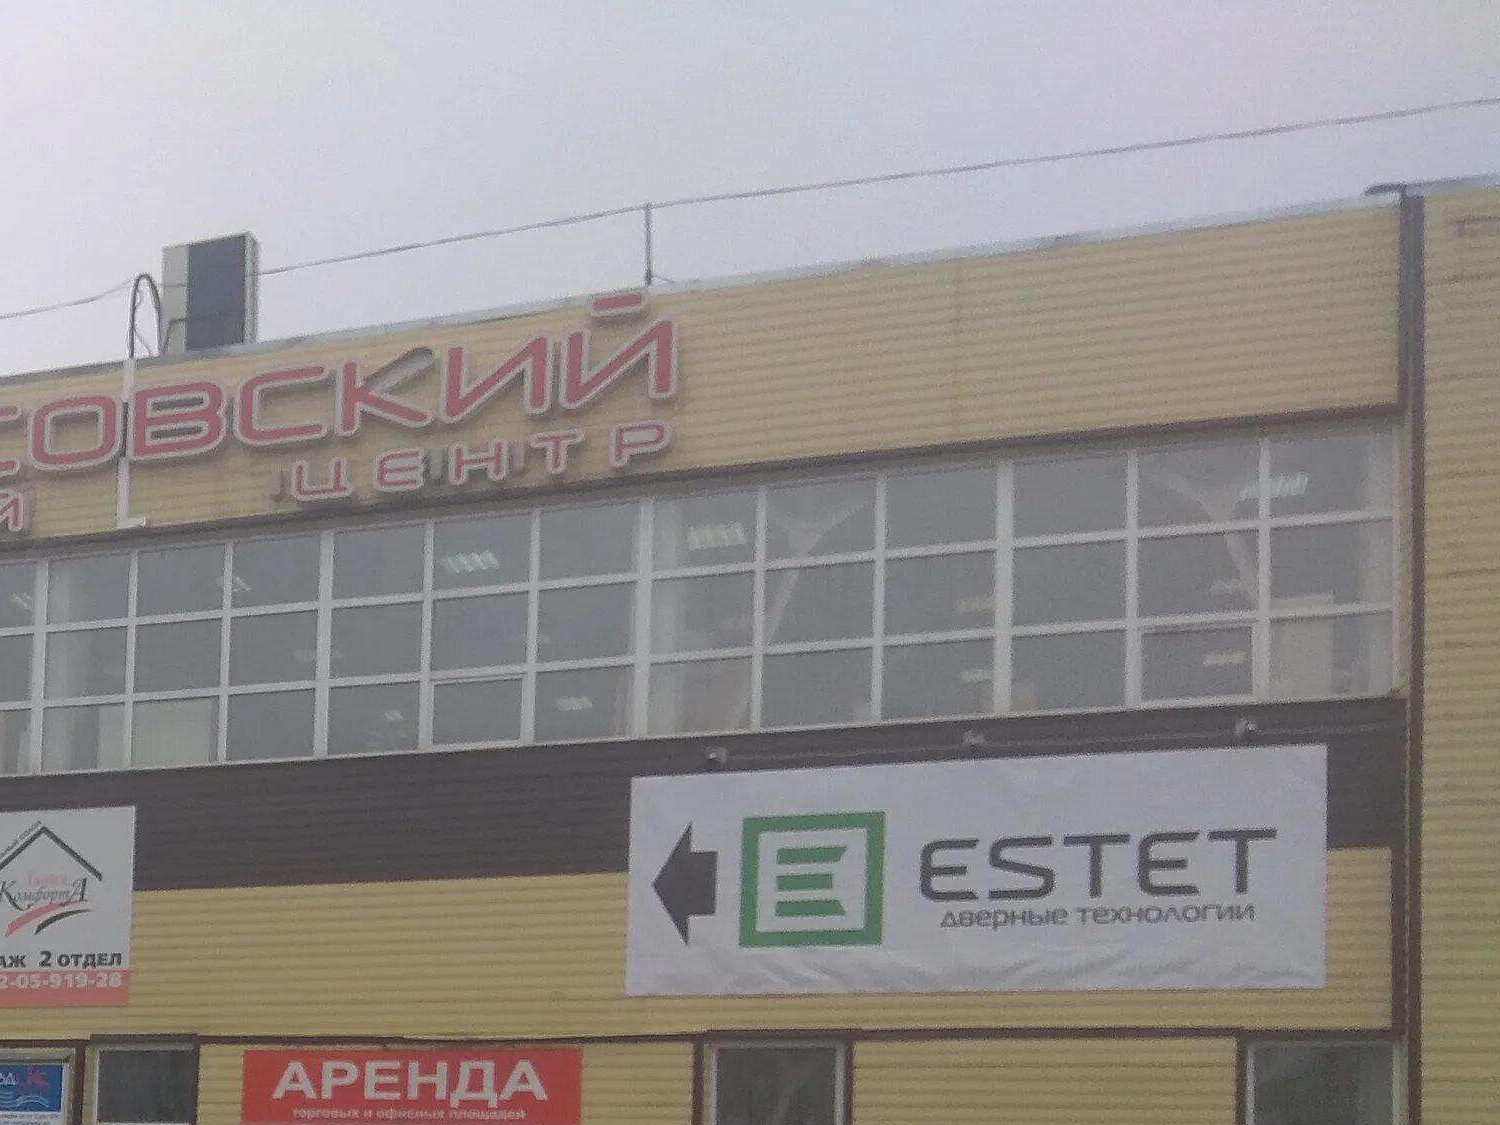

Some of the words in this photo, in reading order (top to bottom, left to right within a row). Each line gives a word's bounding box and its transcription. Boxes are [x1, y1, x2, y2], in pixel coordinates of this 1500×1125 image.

[291, 420, 671, 499] ЦЕНТР
[918, 828, 1278, 901] ESTET
[38, 951, 52, 968] 2
[56, 952, 122, 969] ОТДЕЛ
[271, 1059, 548, 1108] АРЕНДА
[293, 1107, 360, 1121] торговых
[363, 1109, 373, 1119] и
[376, 1107, 445, 1121] офисных
[449, 1108, 527, 1121] площадей
